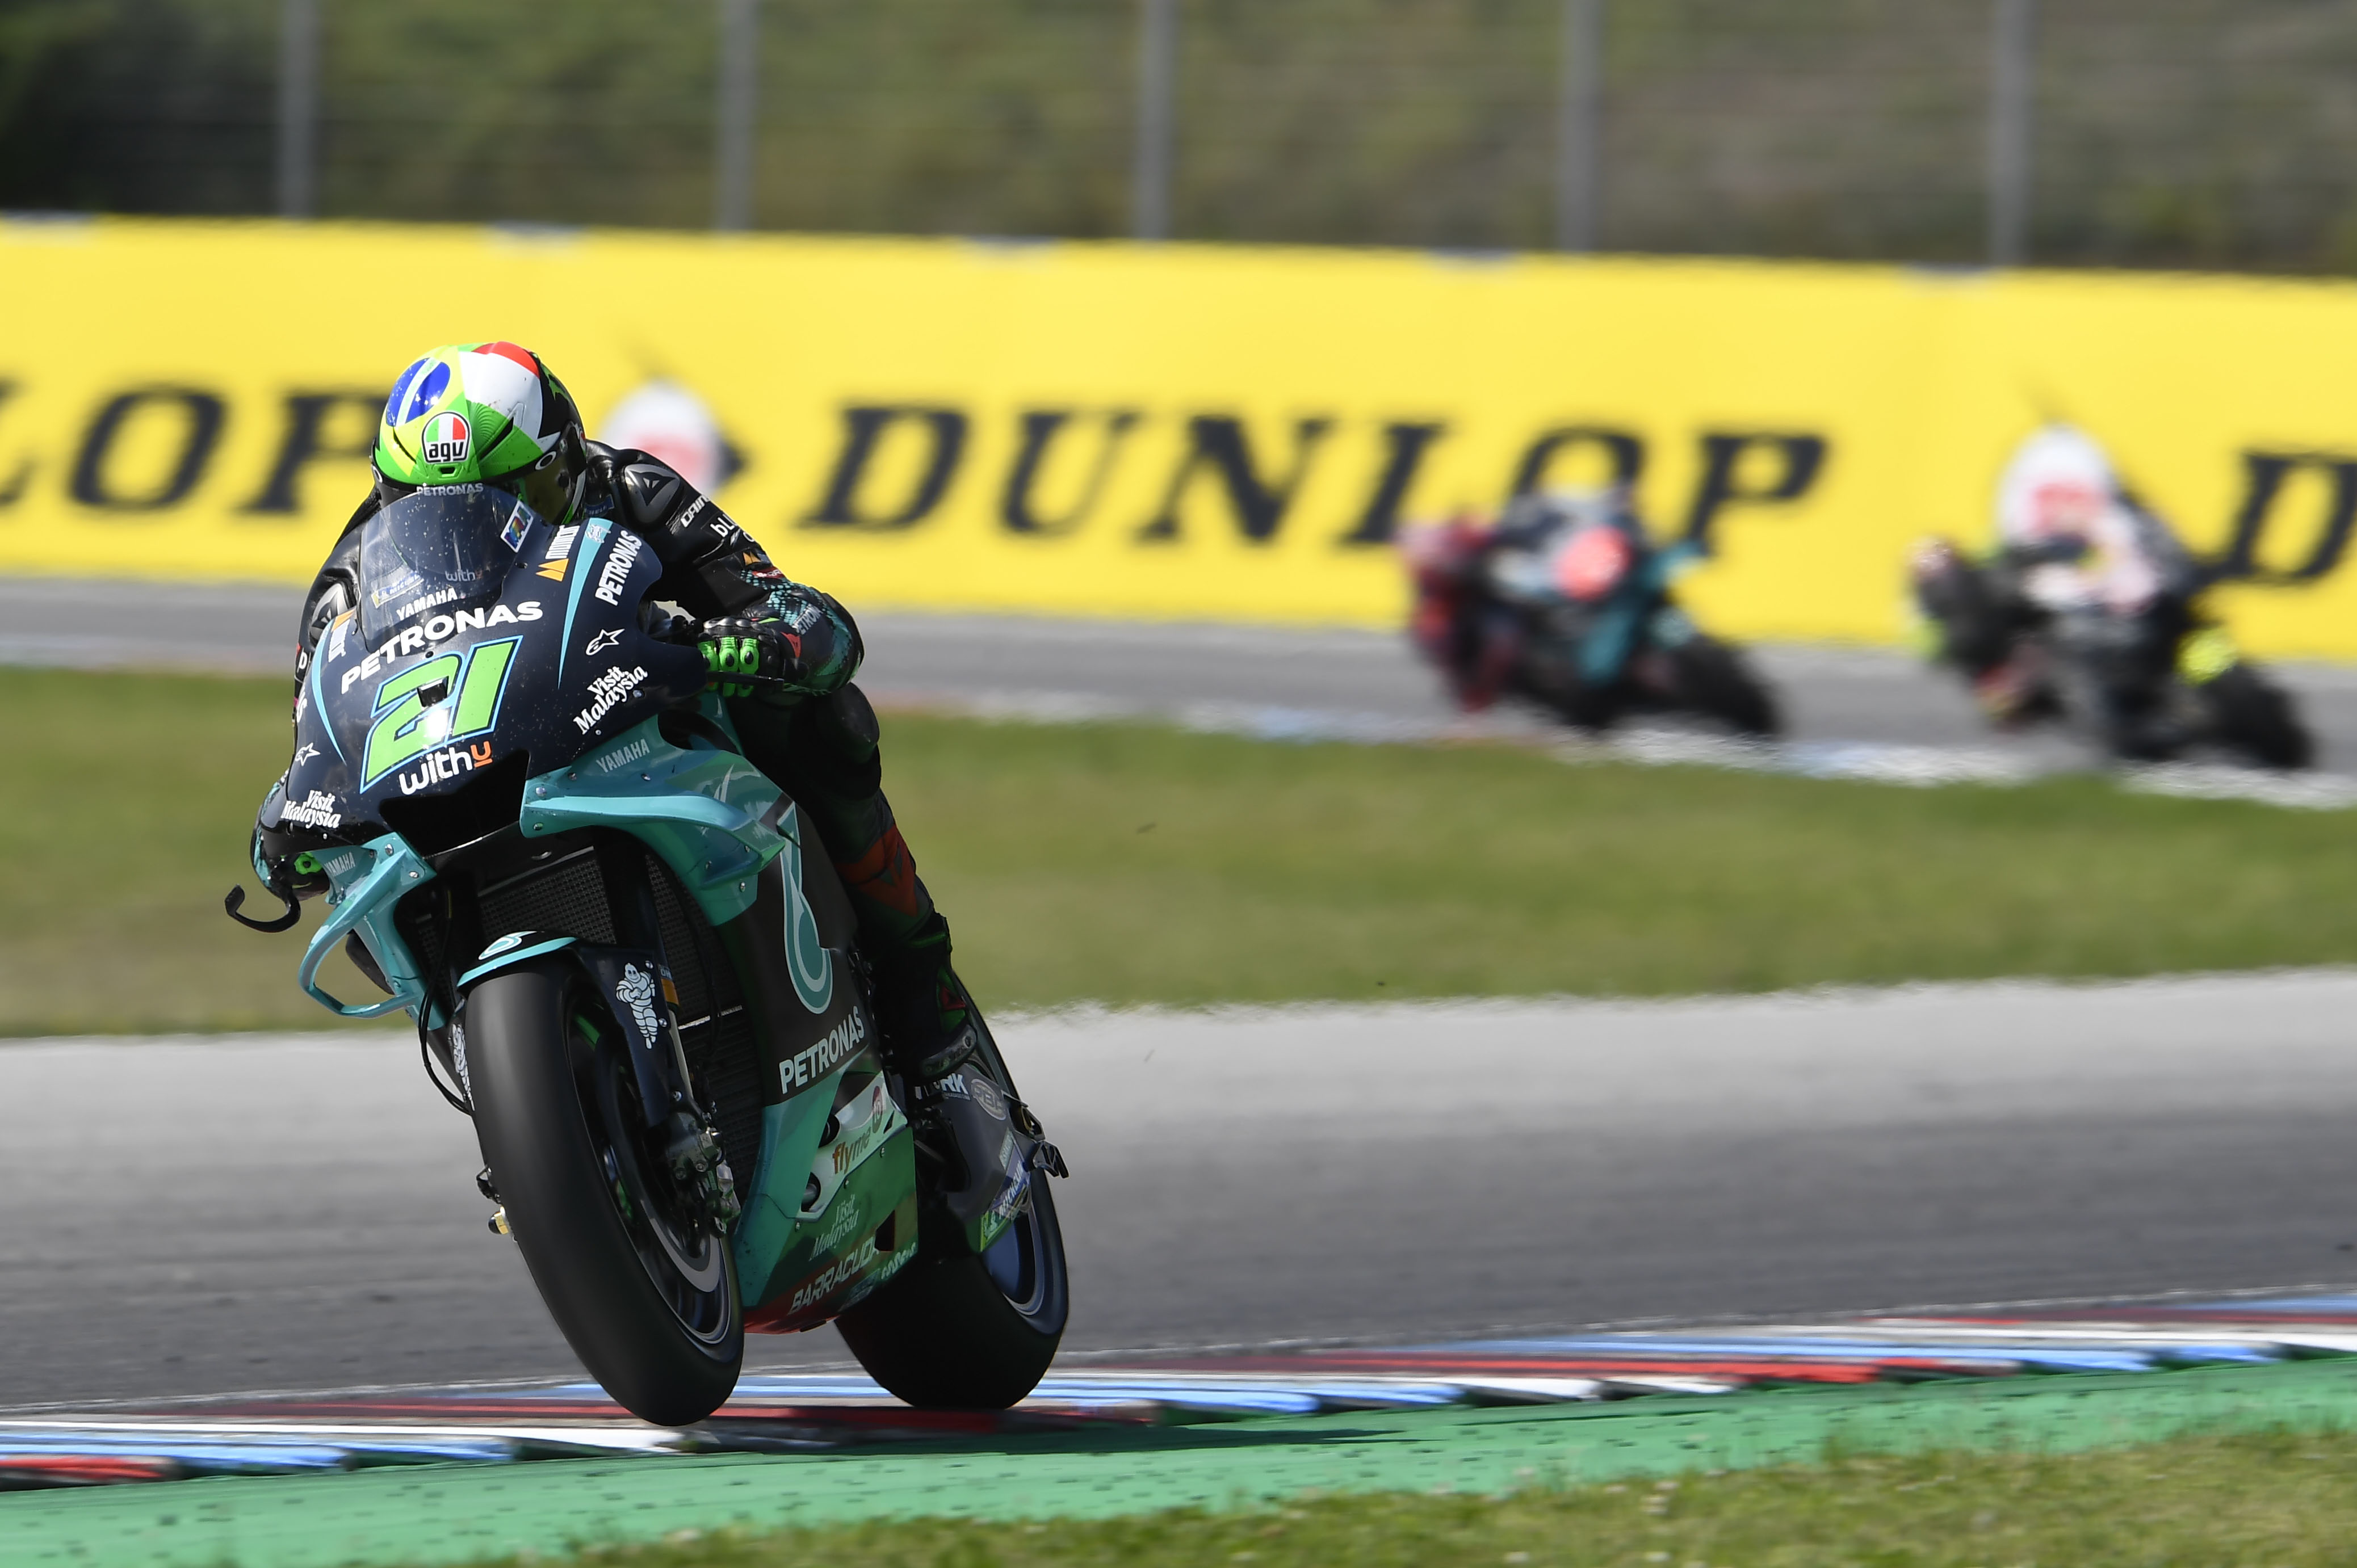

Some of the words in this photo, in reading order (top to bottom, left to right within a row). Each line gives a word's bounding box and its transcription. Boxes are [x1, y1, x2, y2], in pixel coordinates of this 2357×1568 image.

[429, 441, 464, 462] agv
[416, 482, 484, 497] PETRONAS
[595, 530, 643, 606] PETRONAS
[396, 587, 458, 621] YAMAHA
[341, 601, 543, 695] PETRONAS
[588, 666, 626, 696] Visit
[359, 634, 524, 794] 21
[573, 666, 648, 734] Malaysia
[596, 739, 651, 773] YAMAHA
[280, 801, 342, 829] Malaysia
[307, 790, 335, 813] Visit
[324, 852, 355, 876] YAMAHA
[779, 1007, 865, 1095] PETRONAS
[832, 1126, 871, 1174] flyme
